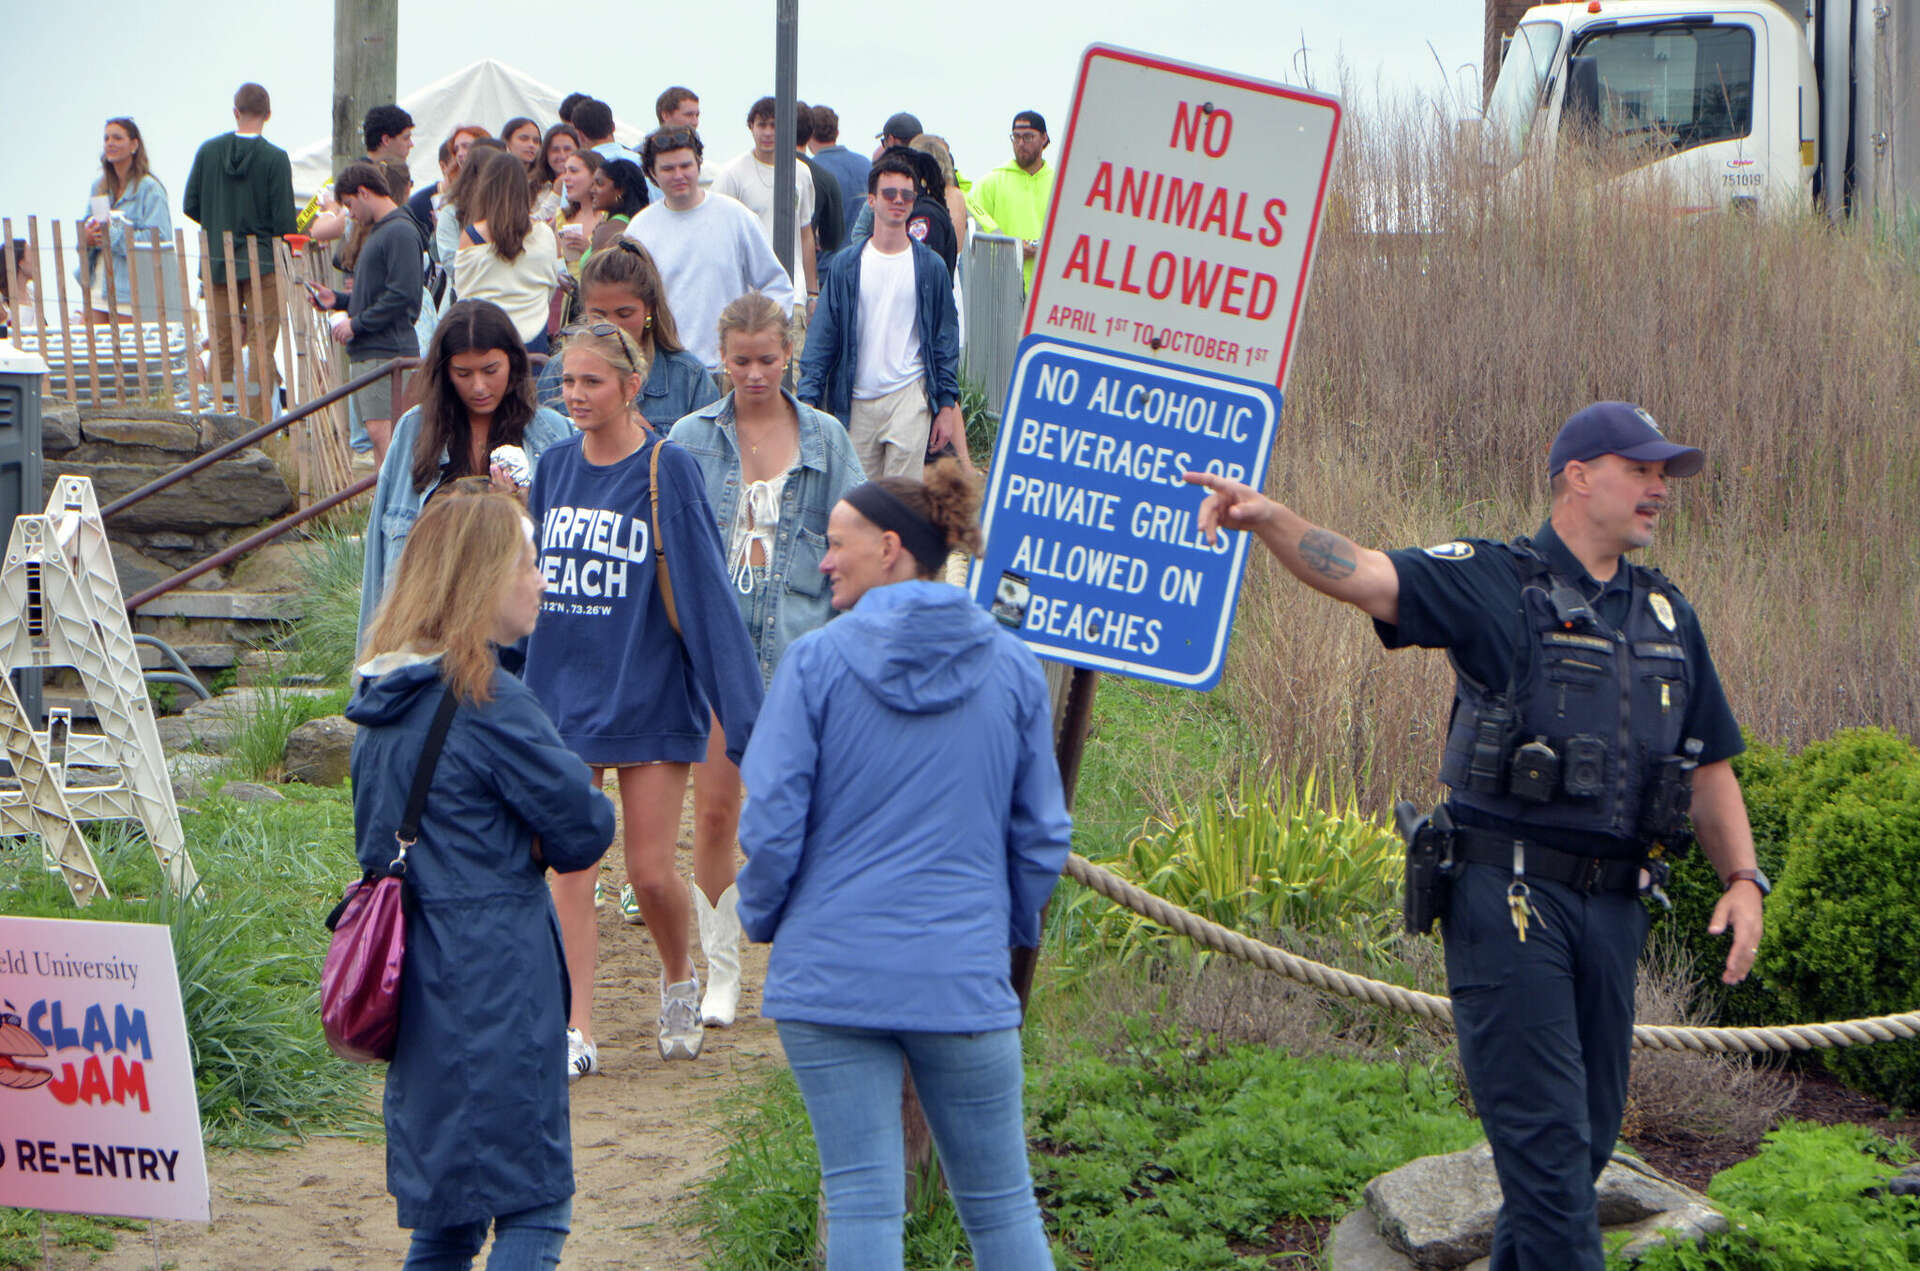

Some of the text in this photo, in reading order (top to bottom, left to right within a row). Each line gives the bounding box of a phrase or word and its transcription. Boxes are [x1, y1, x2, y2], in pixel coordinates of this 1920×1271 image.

[1169, 101, 1233, 158] NO
[1085, 161, 1287, 247] ANIMALS
[1062, 234, 1278, 321] ALLOWED
[1047, 304, 1269, 367] APRIL 1ST TO OCTOBER 1ST
[1035, 364, 1252, 443] NO ALCOHOLIC
[1017, 418, 1192, 488] BEVERAGES
[1003, 474, 1120, 532] PRIVATE
[542, 506, 648, 563] IRFIELD
[539, 555, 628, 598] EACH
[1011, 535, 1203, 607] ALLOWED ON
[1025, 595, 1163, 655] BEACHES
[32, 951, 138, 989] University
[27, 999, 153, 1060] CLAM
[47, 1054, 150, 1113] JAM
[15, 1139, 179, 1181] RE-ENTRY
